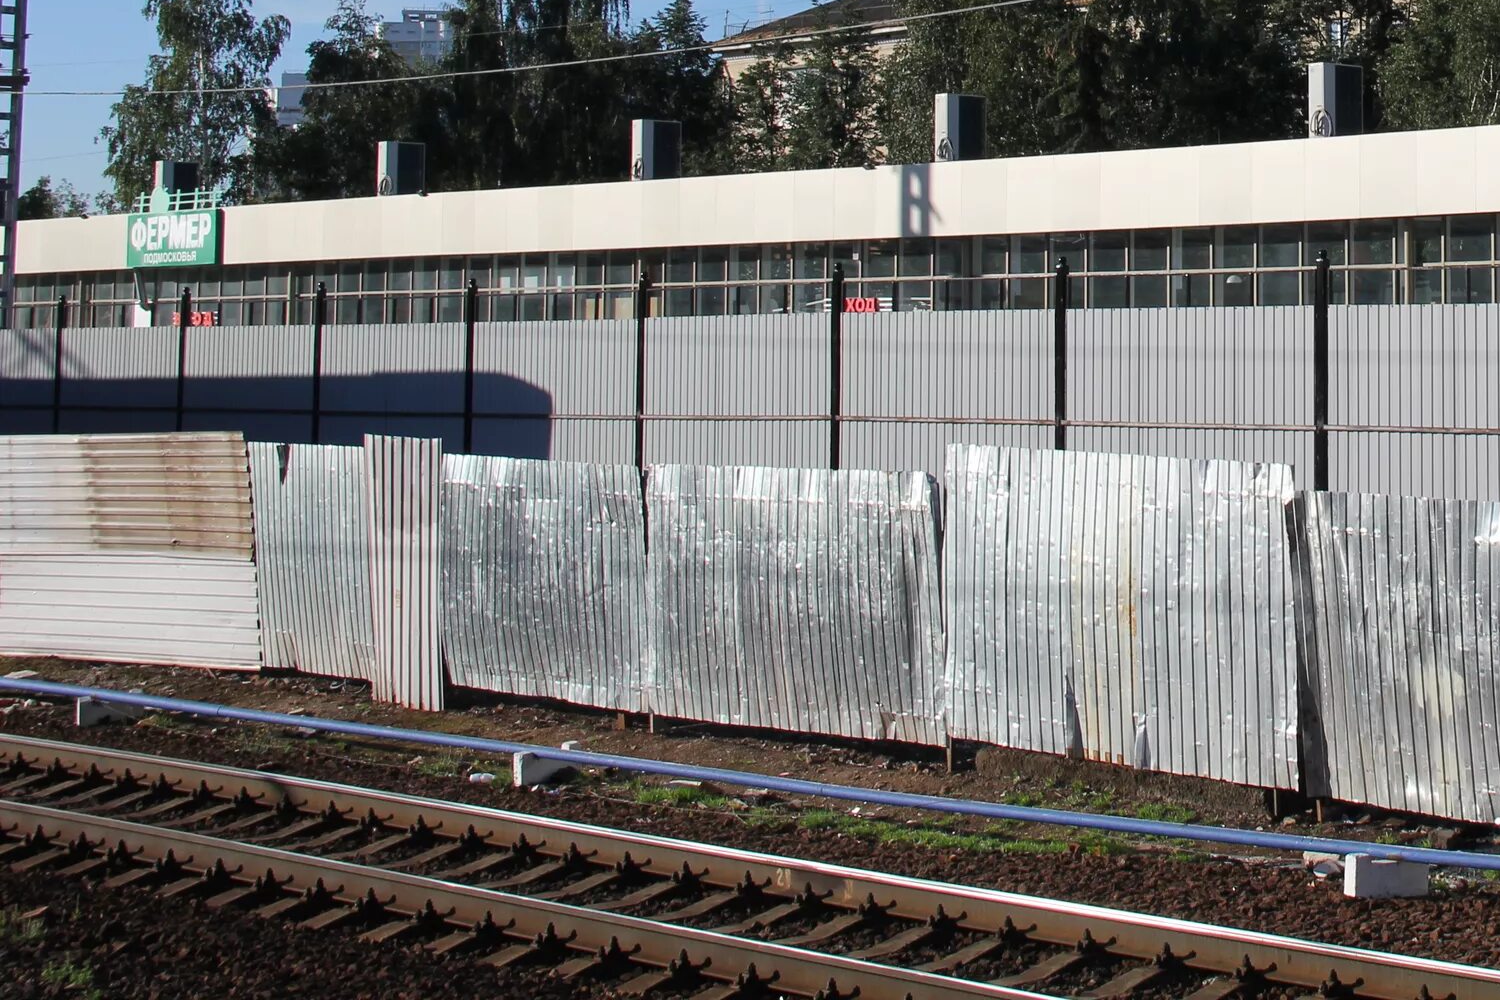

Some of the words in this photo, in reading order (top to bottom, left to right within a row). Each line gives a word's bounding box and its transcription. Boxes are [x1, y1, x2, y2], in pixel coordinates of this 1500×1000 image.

[131, 213, 212, 252] ФЕРМЕР
[143, 251, 197, 264] ПОДМОСКОВЬЯ
[845, 297, 876, 313] ХОД
[172, 311, 213, 328] ВОД
